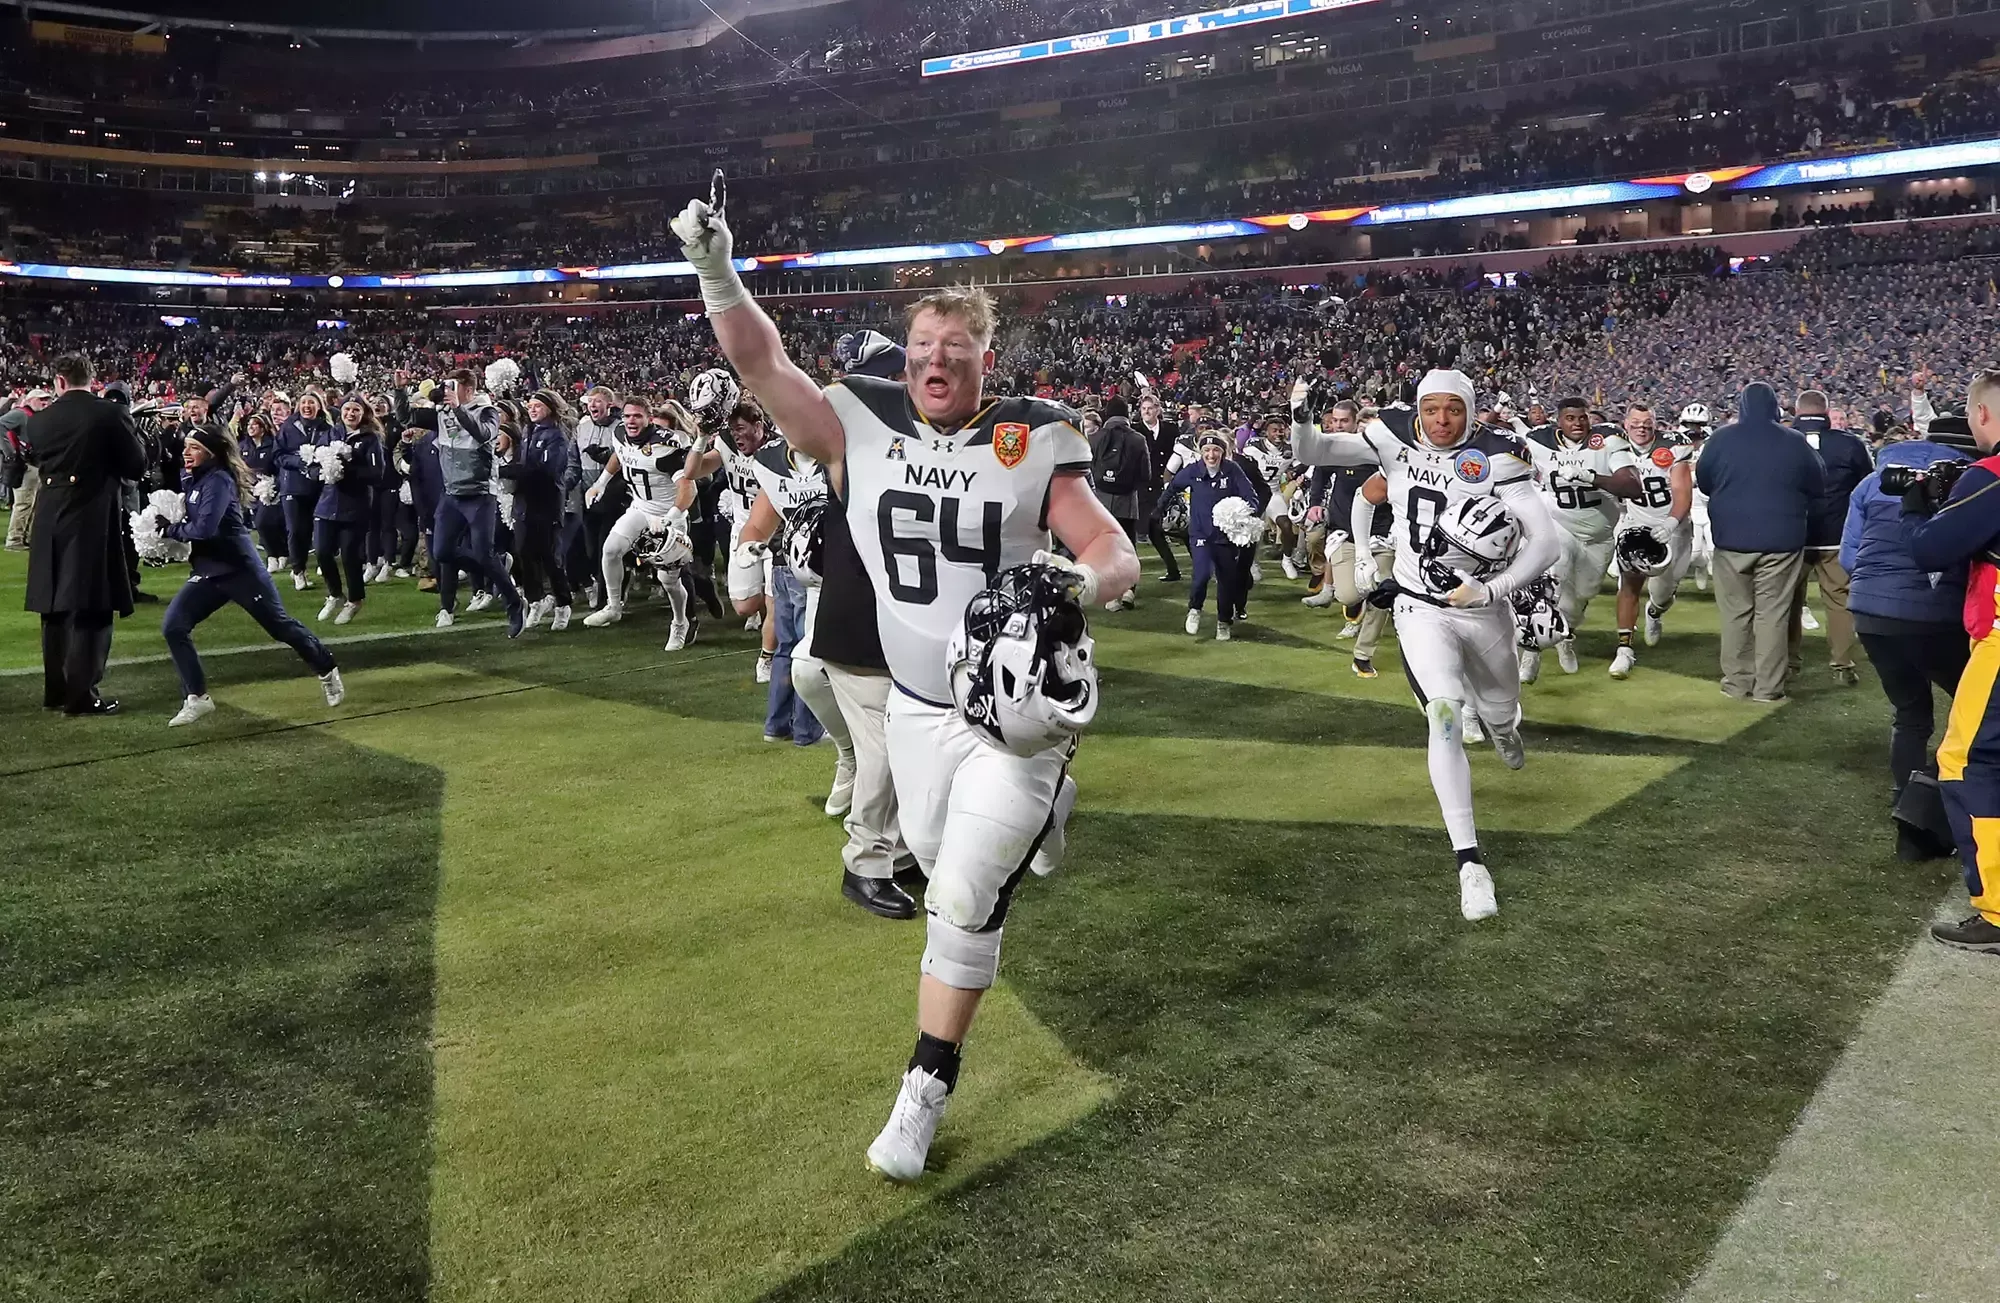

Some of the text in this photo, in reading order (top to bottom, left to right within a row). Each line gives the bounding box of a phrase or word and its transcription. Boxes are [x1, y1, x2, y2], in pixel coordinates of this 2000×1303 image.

[1541, 24, 1593, 41] EXCHANGE
[1339, 62, 1363, 75] USAA
[1106, 97, 1129, 108] USAA
[1799, 162, 1847, 179] Thank
[1369, 208, 1403, 222] Thank
[1405, 206, 1427, 220] you
[622, 455, 639, 467] NAVY
[1265, 459, 1283, 467] NAVY
[1558, 459, 1584, 468] NAVY
[904, 463, 978, 493] NAVY
[1407, 465, 1454, 490] NAVY
[1407, 485, 1449, 557] 0
[877, 488, 1003, 605] 64
[1453, 532, 1470, 546] NAVY
